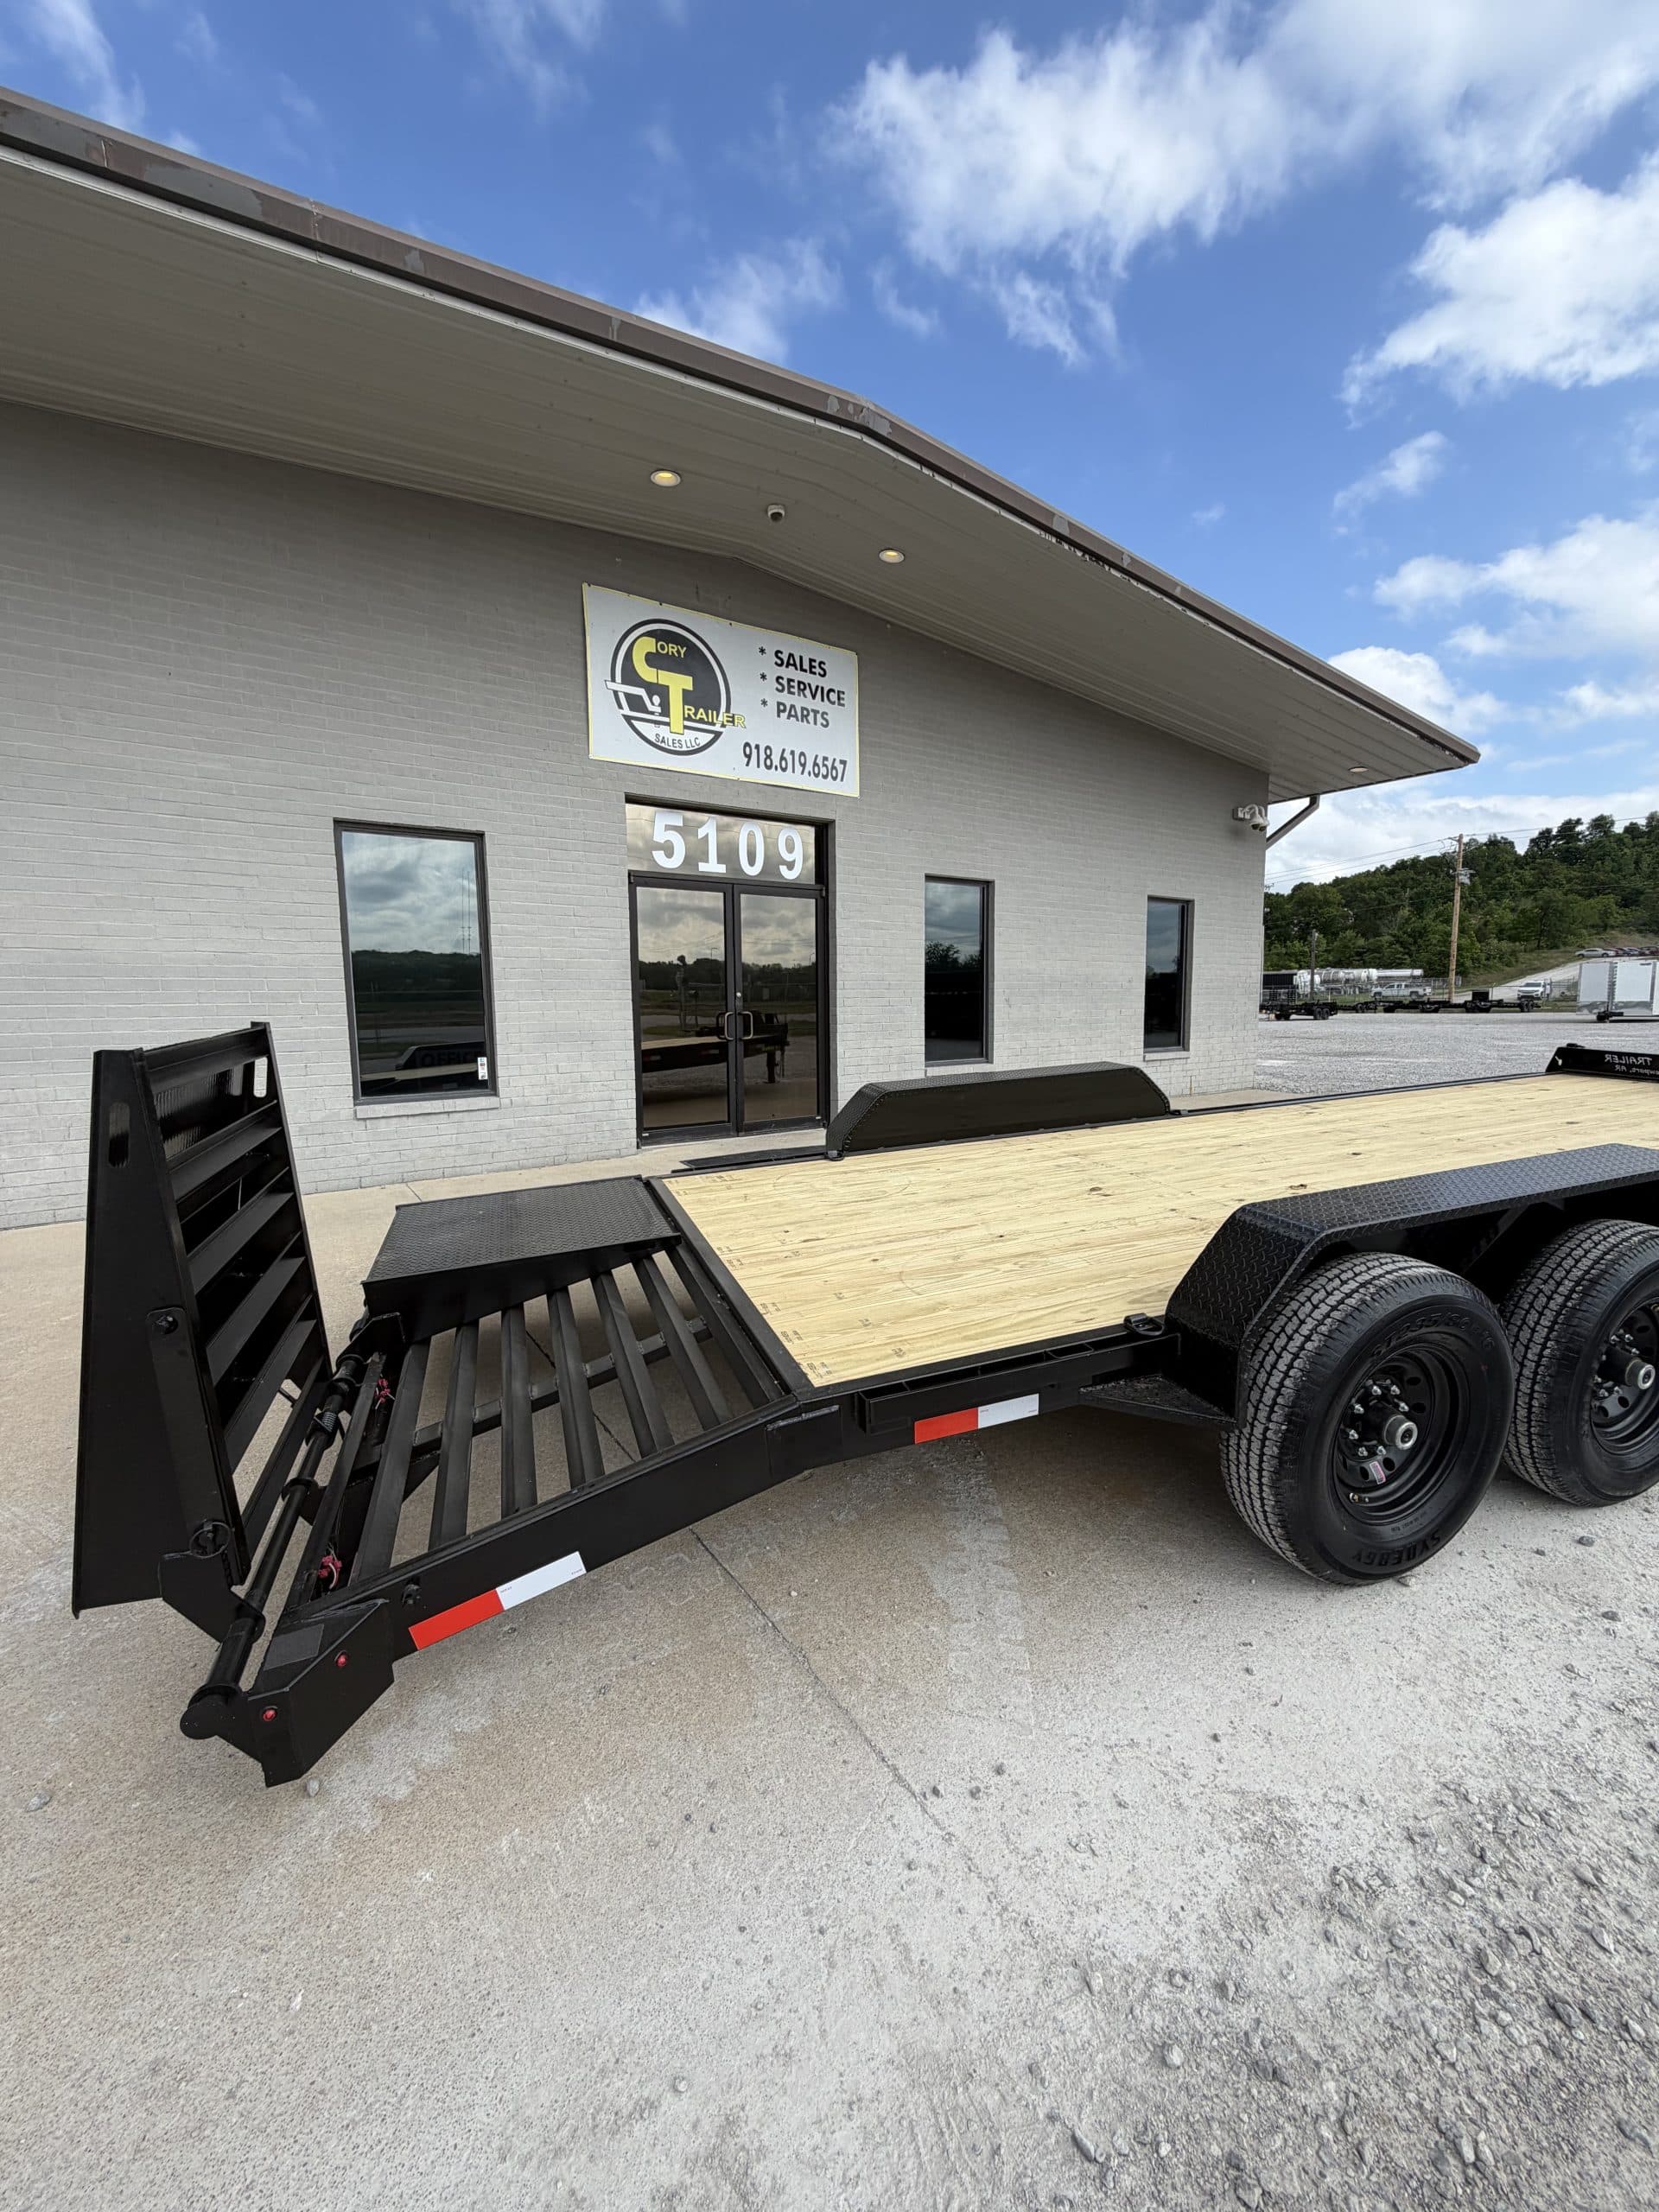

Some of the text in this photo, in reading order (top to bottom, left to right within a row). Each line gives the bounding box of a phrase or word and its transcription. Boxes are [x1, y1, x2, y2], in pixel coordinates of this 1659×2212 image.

[773, 649, 827, 678] SALES
[774, 675, 846, 708] SERVICE
[776, 701, 830, 728] PARTS
[654, 733, 701, 749] SALES LLC
[742, 741, 848, 783] 918.619.6567
[652, 811, 804, 880] 5109
